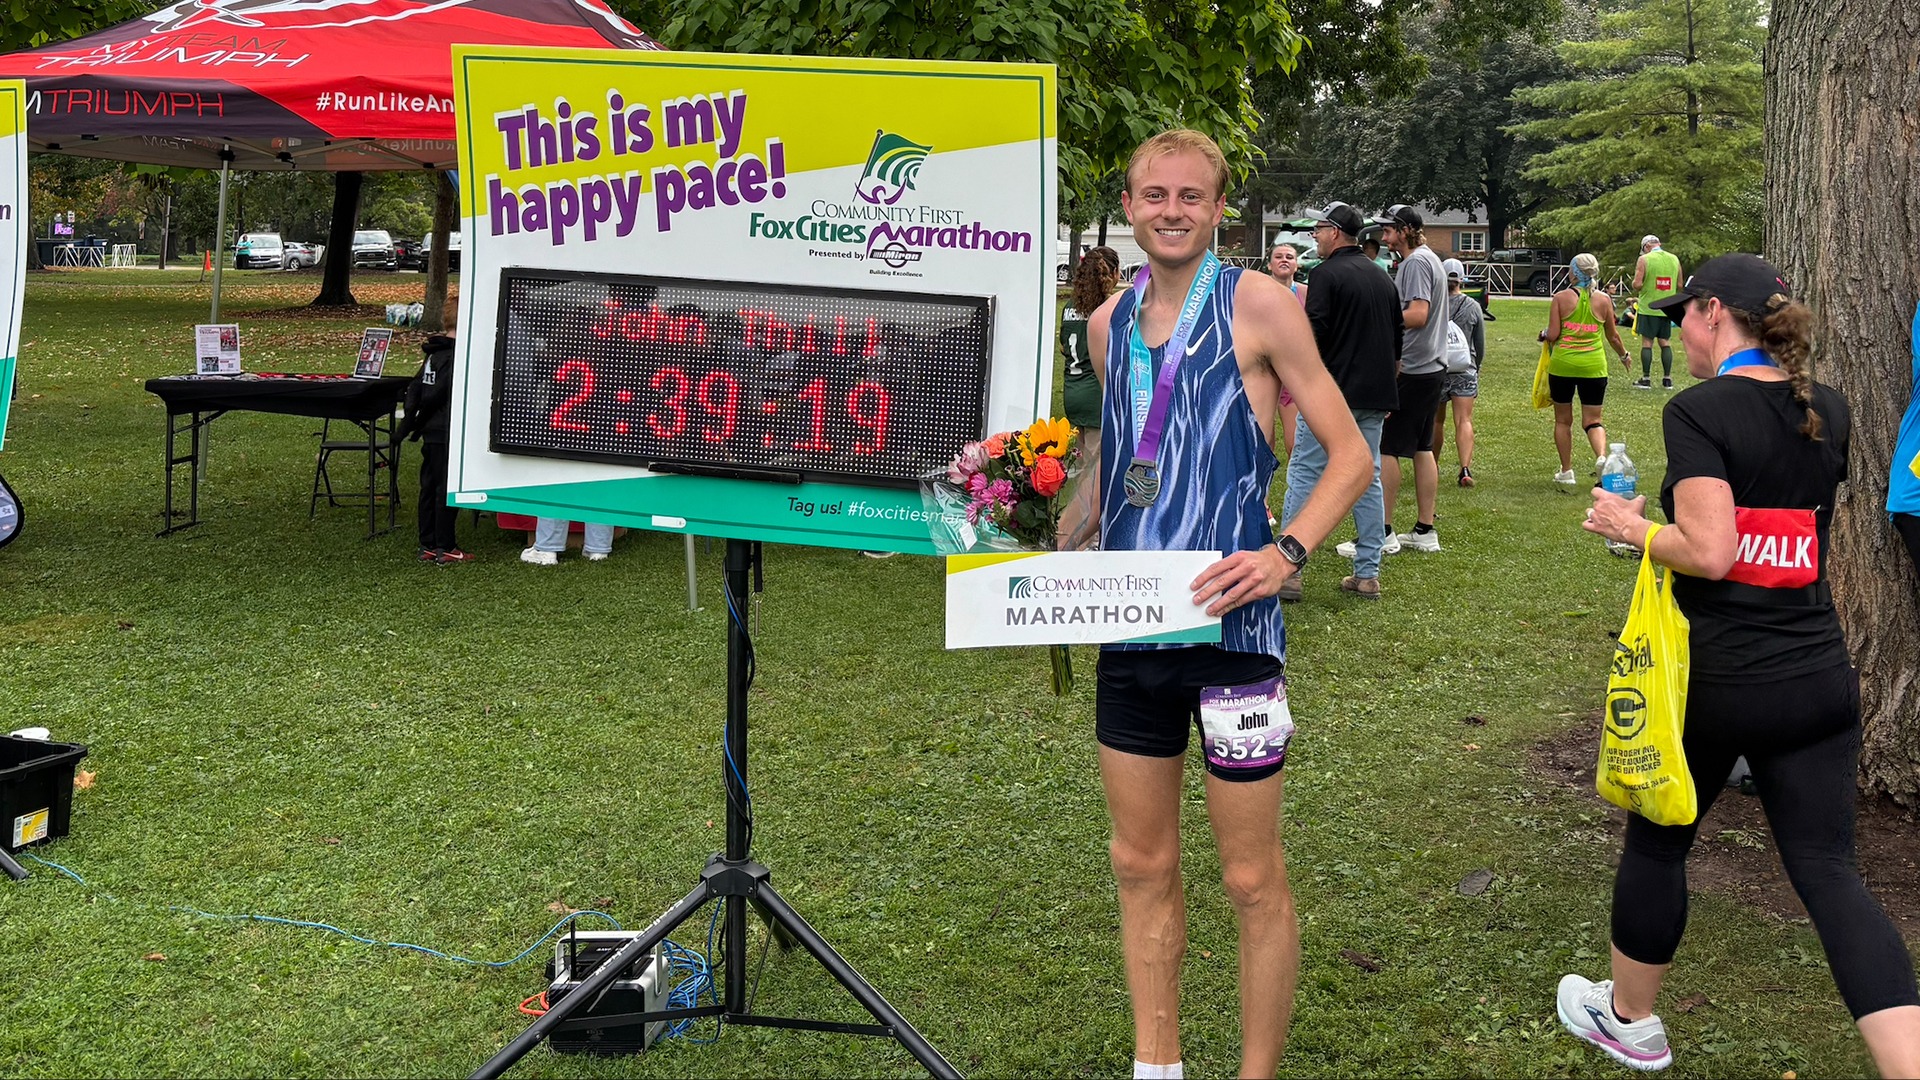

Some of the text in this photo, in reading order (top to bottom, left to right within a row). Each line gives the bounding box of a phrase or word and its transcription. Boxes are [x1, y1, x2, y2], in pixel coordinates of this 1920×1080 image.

[90, 33, 287, 55] MY TEAM
[35, 47, 310, 69] TRIUMPH
[495, 91, 748, 171] This is my
[487, 138, 787, 246] happy pace!
[811, 199, 964, 225] COMMUNITY FIRST
[866, 221, 1032, 260] Marathon
[809, 249, 865, 262] Presented by
[869, 269, 891, 277] Building
[1183, 258, 1217, 322] MARATHON
[591, 297, 882, 358] John Thill
[1068, 333, 1083, 375] 1
[549, 359, 893, 455] 2:39:19
[787, 496, 815, 518] Tag
[820, 500, 842, 515] us!
[1735, 532, 1813, 569] WALK
[1033, 574, 1162, 592] COMMUNITY FIRST
[1006, 604, 1164, 626] MARATHON
[1220, 693, 1268, 708] MARATHON
[1236, 711, 1269, 731] John
[1213, 734, 1267, 760] 552
